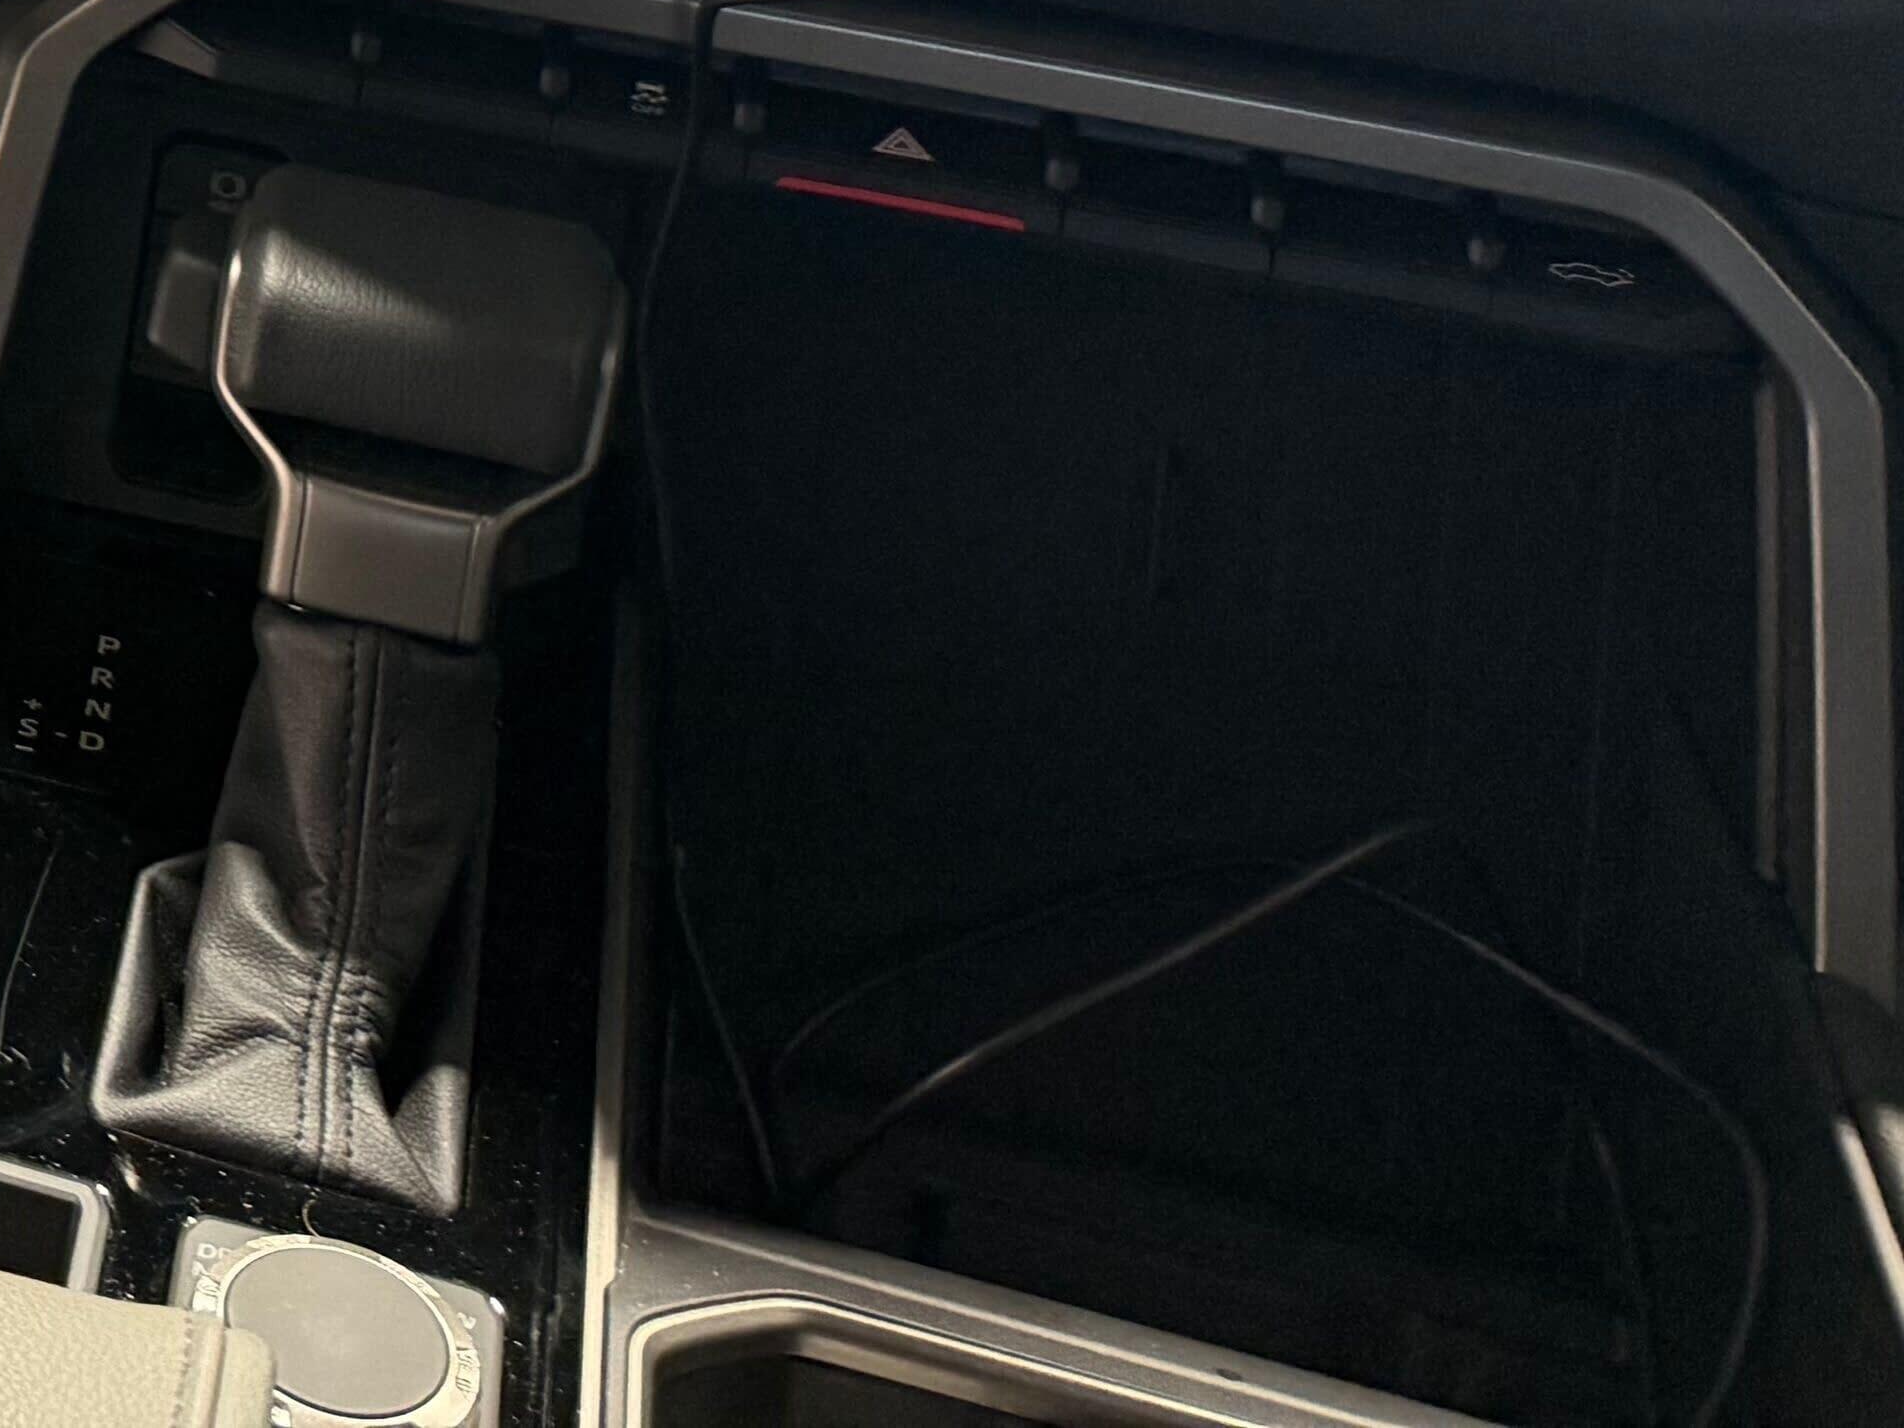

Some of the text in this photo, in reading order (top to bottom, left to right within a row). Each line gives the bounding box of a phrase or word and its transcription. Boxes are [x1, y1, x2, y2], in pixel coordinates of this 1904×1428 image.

[97, 634, 121, 656] P
[91, 666, 115, 690] R
[84, 698, 112, 722] N
[78, 730, 105, 752] D
